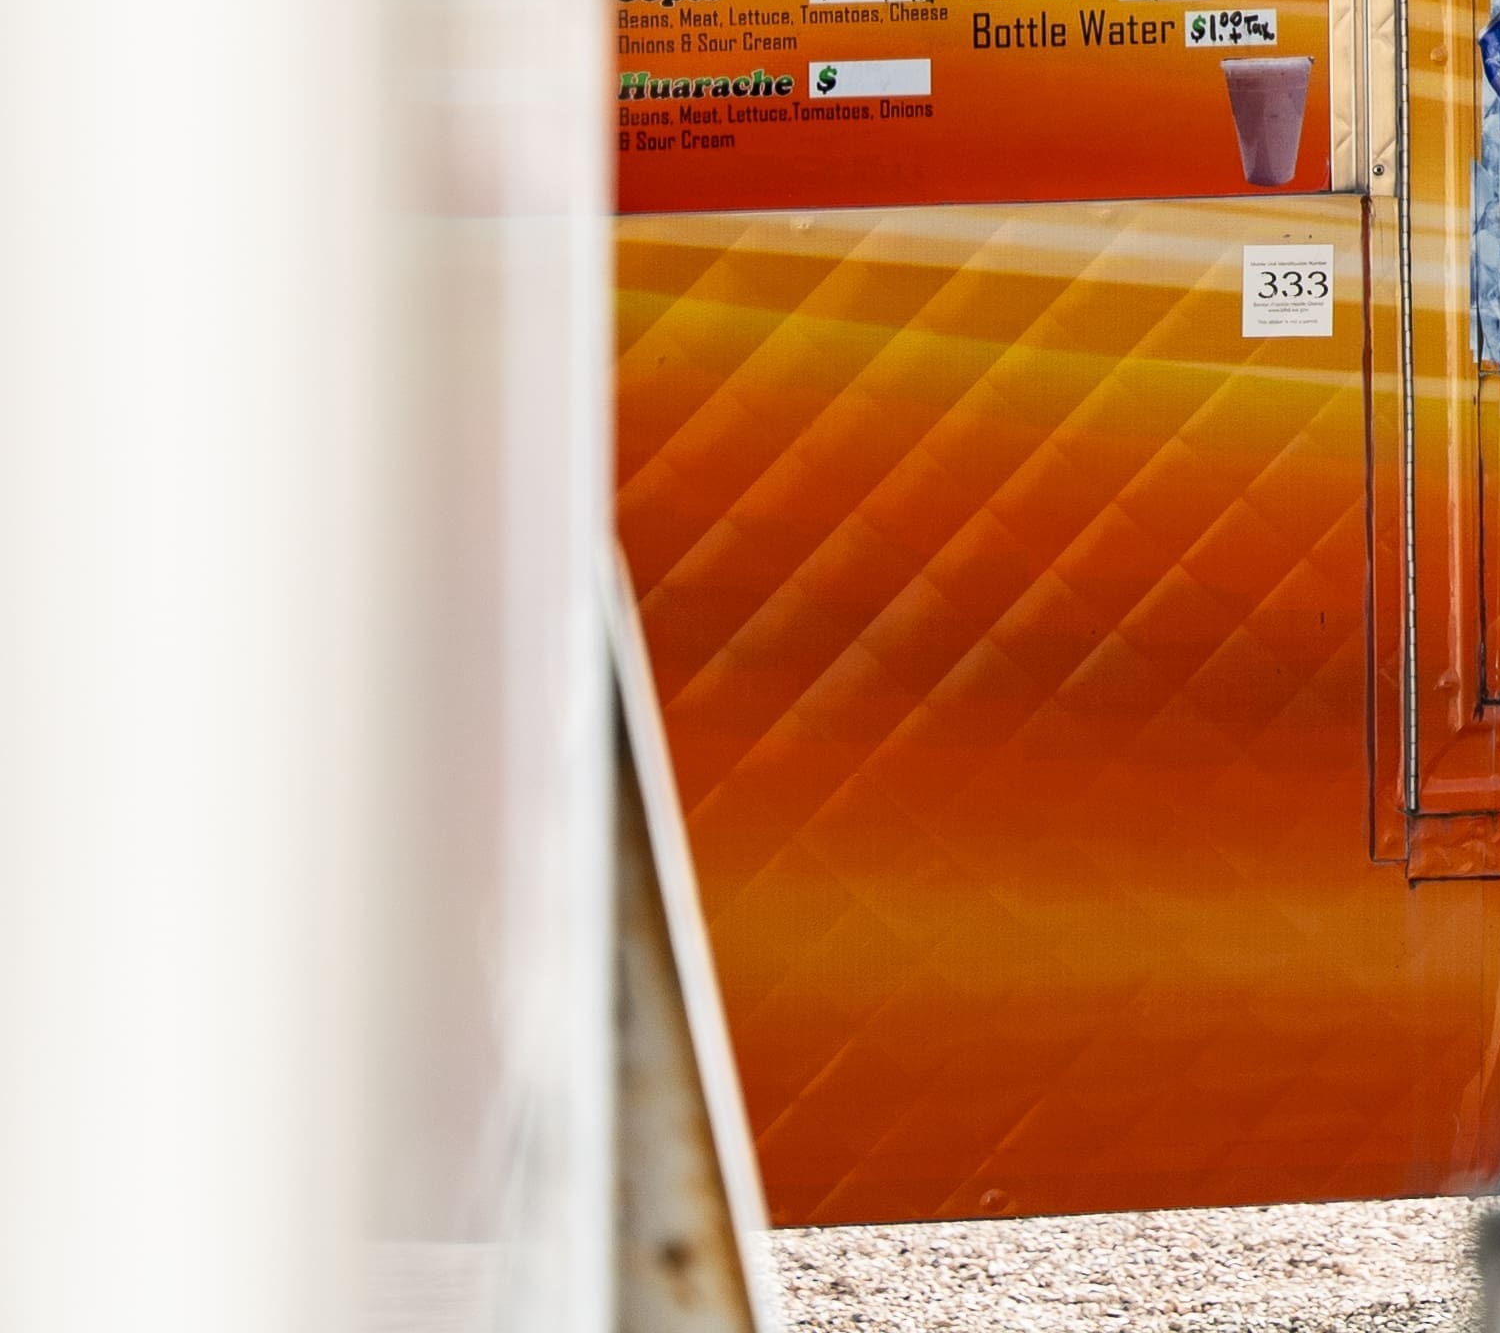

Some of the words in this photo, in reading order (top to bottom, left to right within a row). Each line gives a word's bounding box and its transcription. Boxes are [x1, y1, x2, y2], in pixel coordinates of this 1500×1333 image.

[973, 11, 1066, 49] Bottle
[1080, 9, 1175, 46] Water
[618, 70, 794, 101] Huarache
[1258, 271, 1328, 299] 333
